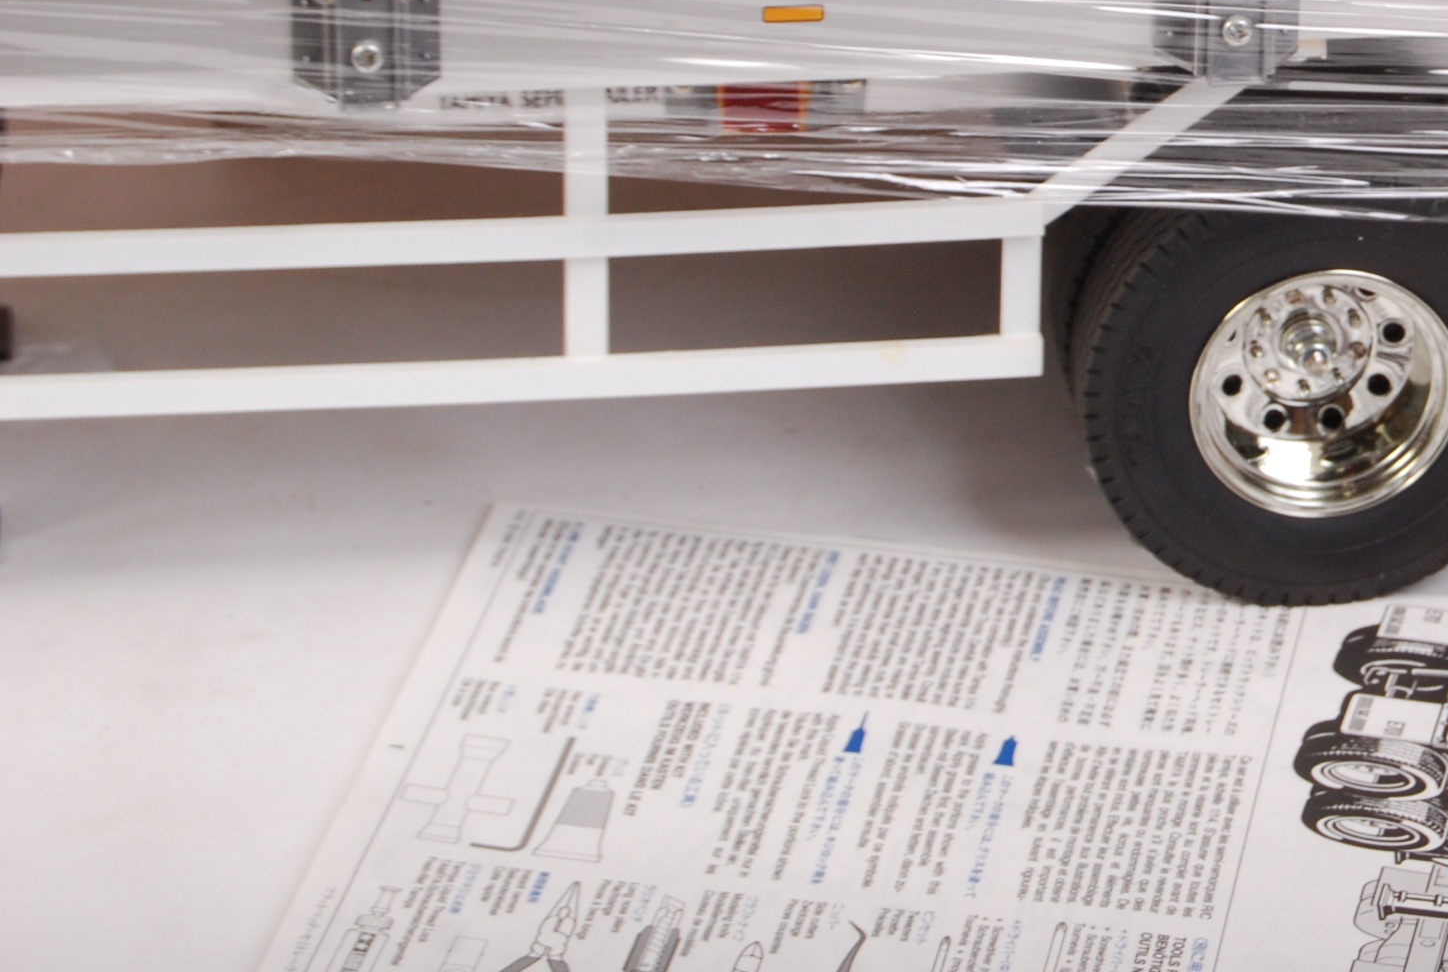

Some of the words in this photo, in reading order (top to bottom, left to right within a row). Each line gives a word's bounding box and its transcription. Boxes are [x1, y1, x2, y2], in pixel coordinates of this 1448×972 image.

[656, 698, 681, 729] OUTILS
[1132, 931, 1154, 965] OUTILS
[1166, 935, 1187, 967] TOOLS
